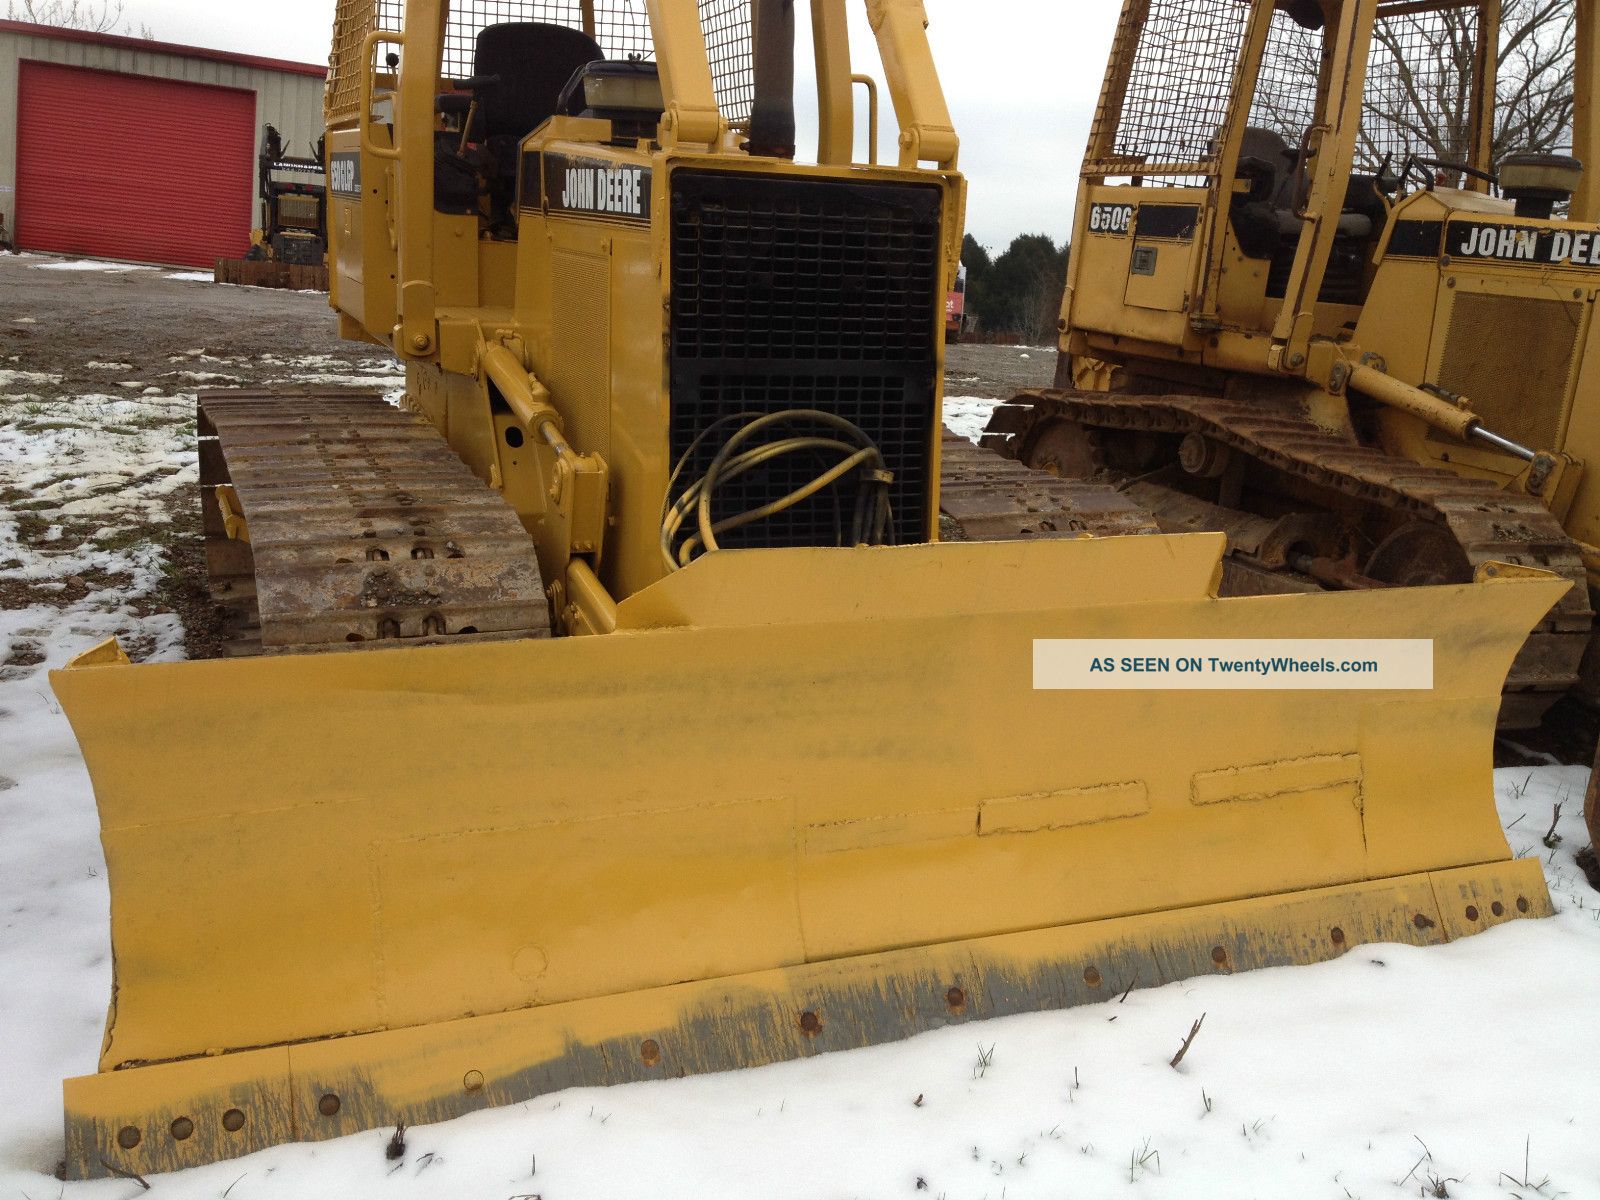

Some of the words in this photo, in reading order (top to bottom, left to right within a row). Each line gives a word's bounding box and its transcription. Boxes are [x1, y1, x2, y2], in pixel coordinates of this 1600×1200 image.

[562, 168, 594, 210] JOHN
[597, 168, 641, 214] DEERE
[1090, 206, 1132, 231] 650G
[1460, 227, 1538, 259] JOHN
